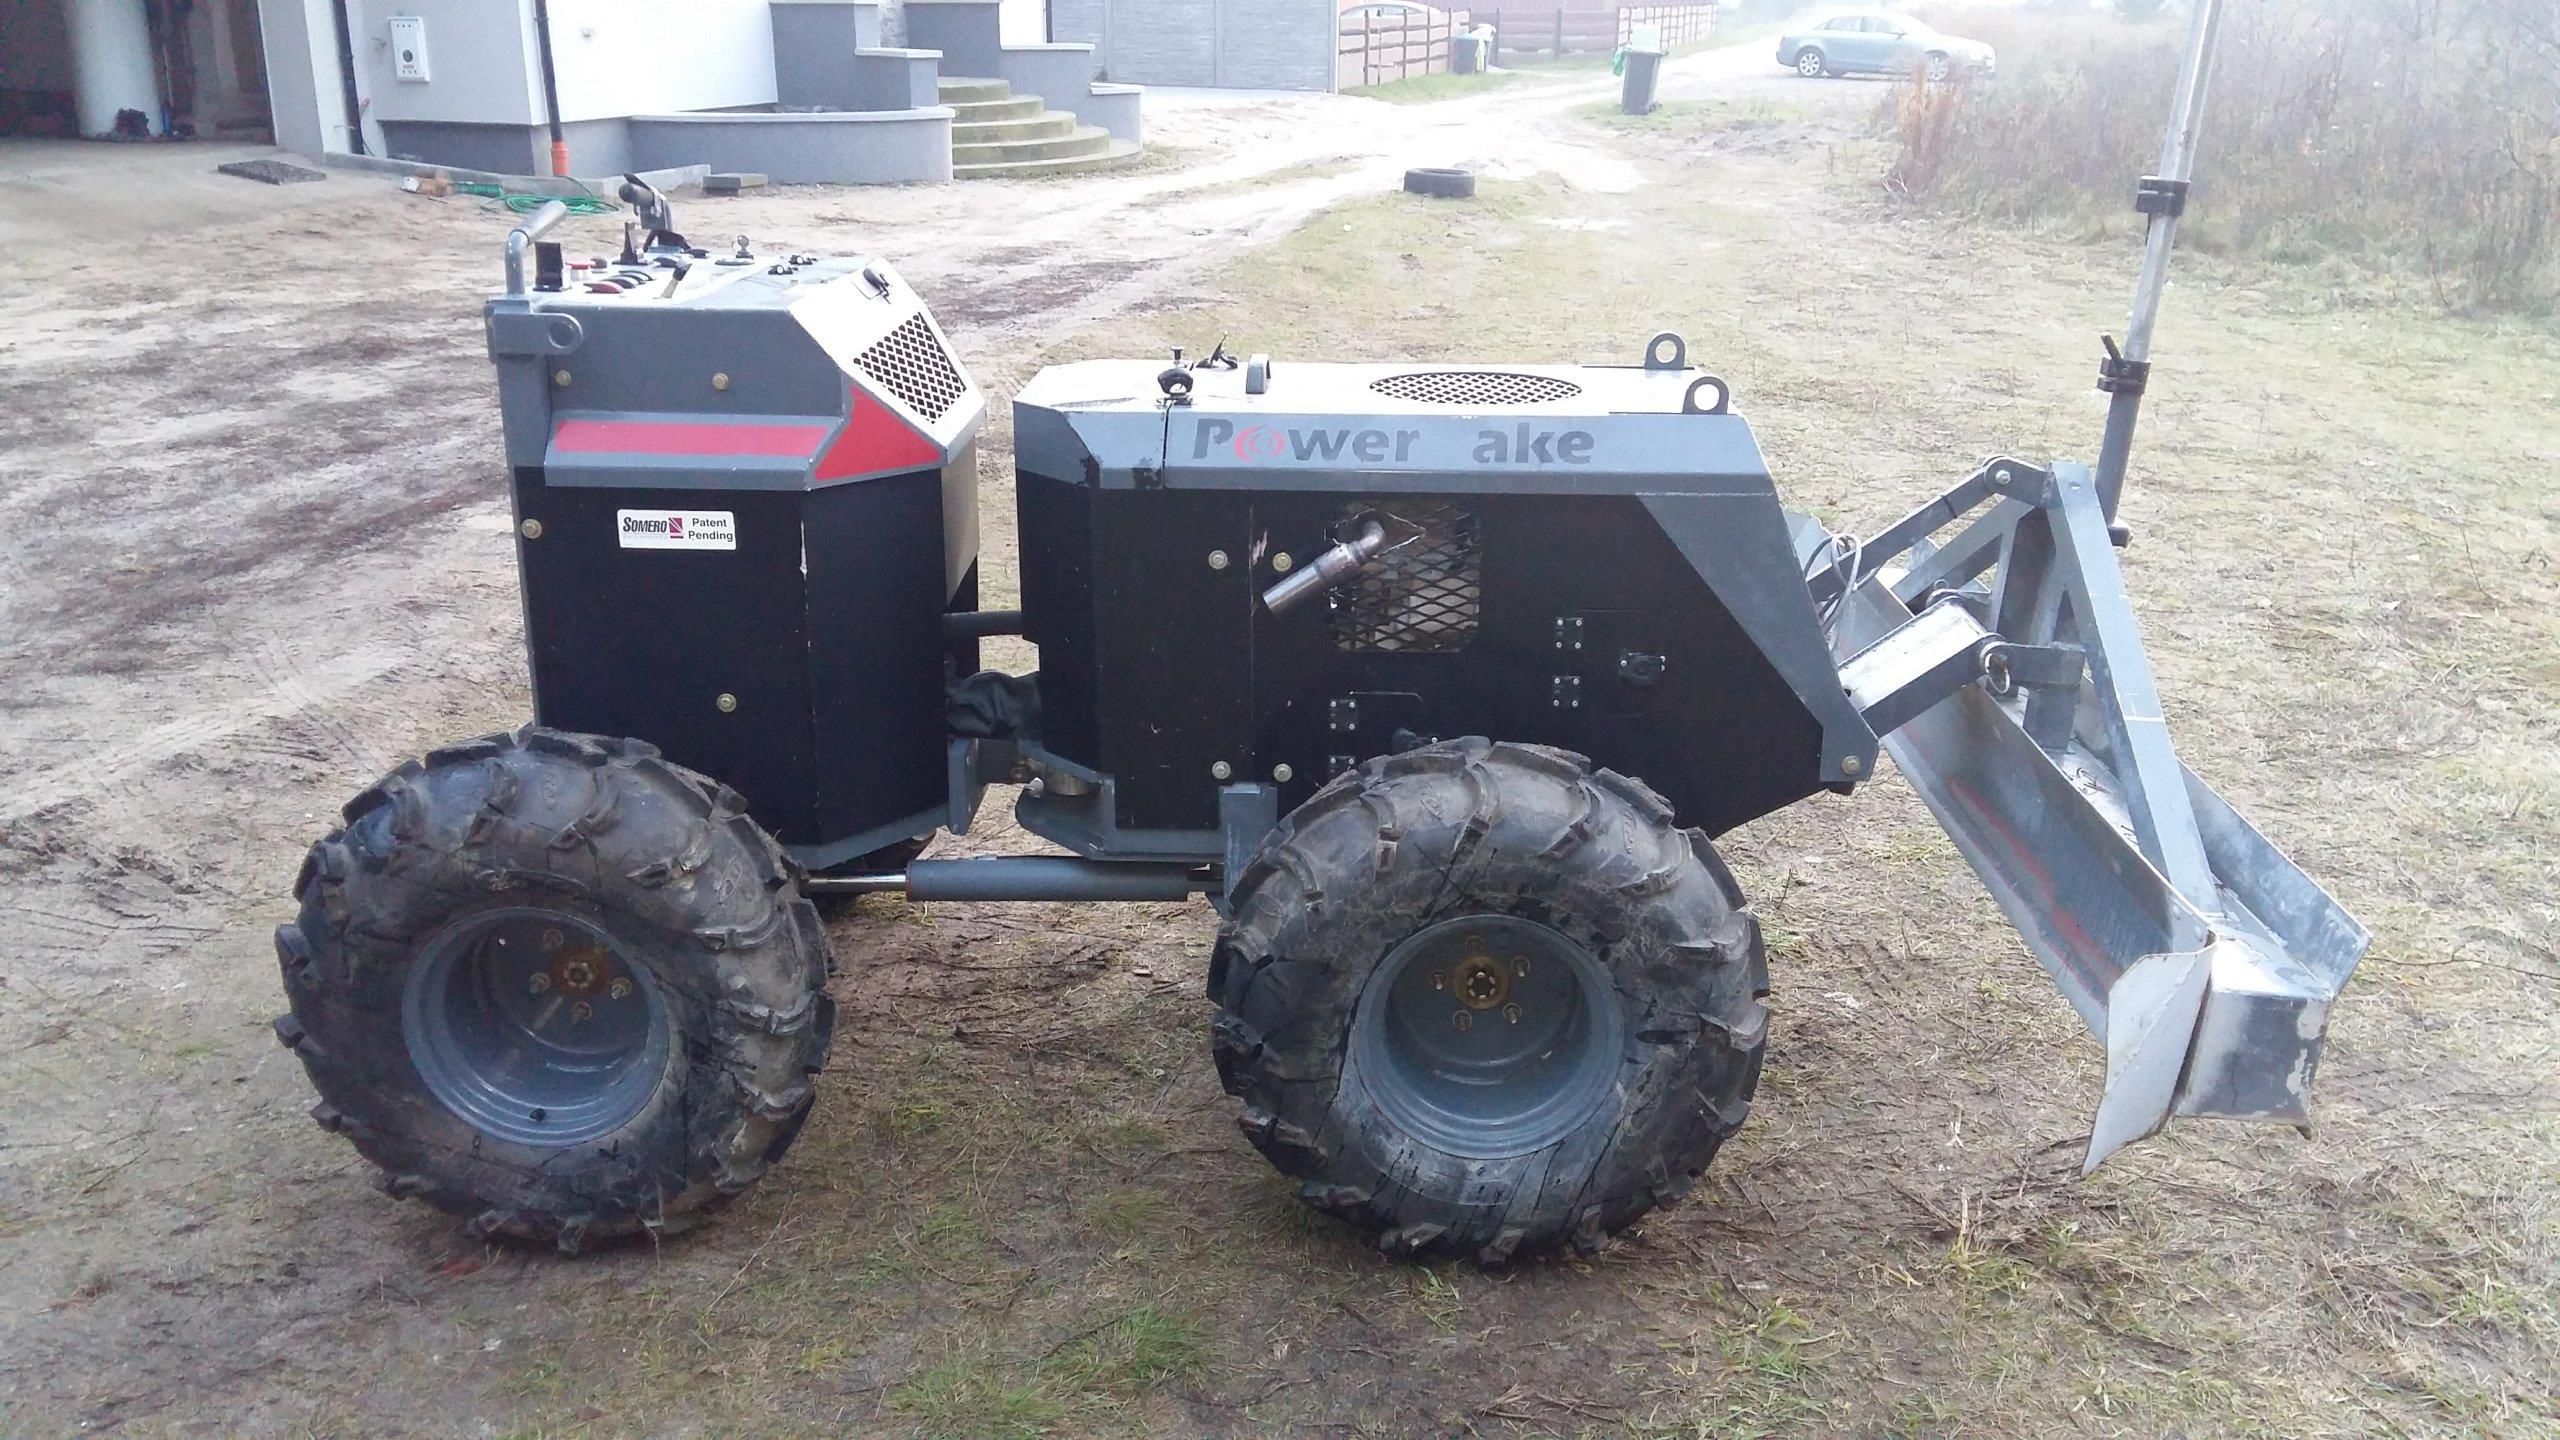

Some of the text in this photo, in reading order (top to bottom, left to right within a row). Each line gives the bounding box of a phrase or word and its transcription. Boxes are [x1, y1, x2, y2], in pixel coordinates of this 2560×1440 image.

[1193, 418, 1420, 463] Power
[692, 517, 727, 528] Patent
[688, 530, 733, 542] Pending
